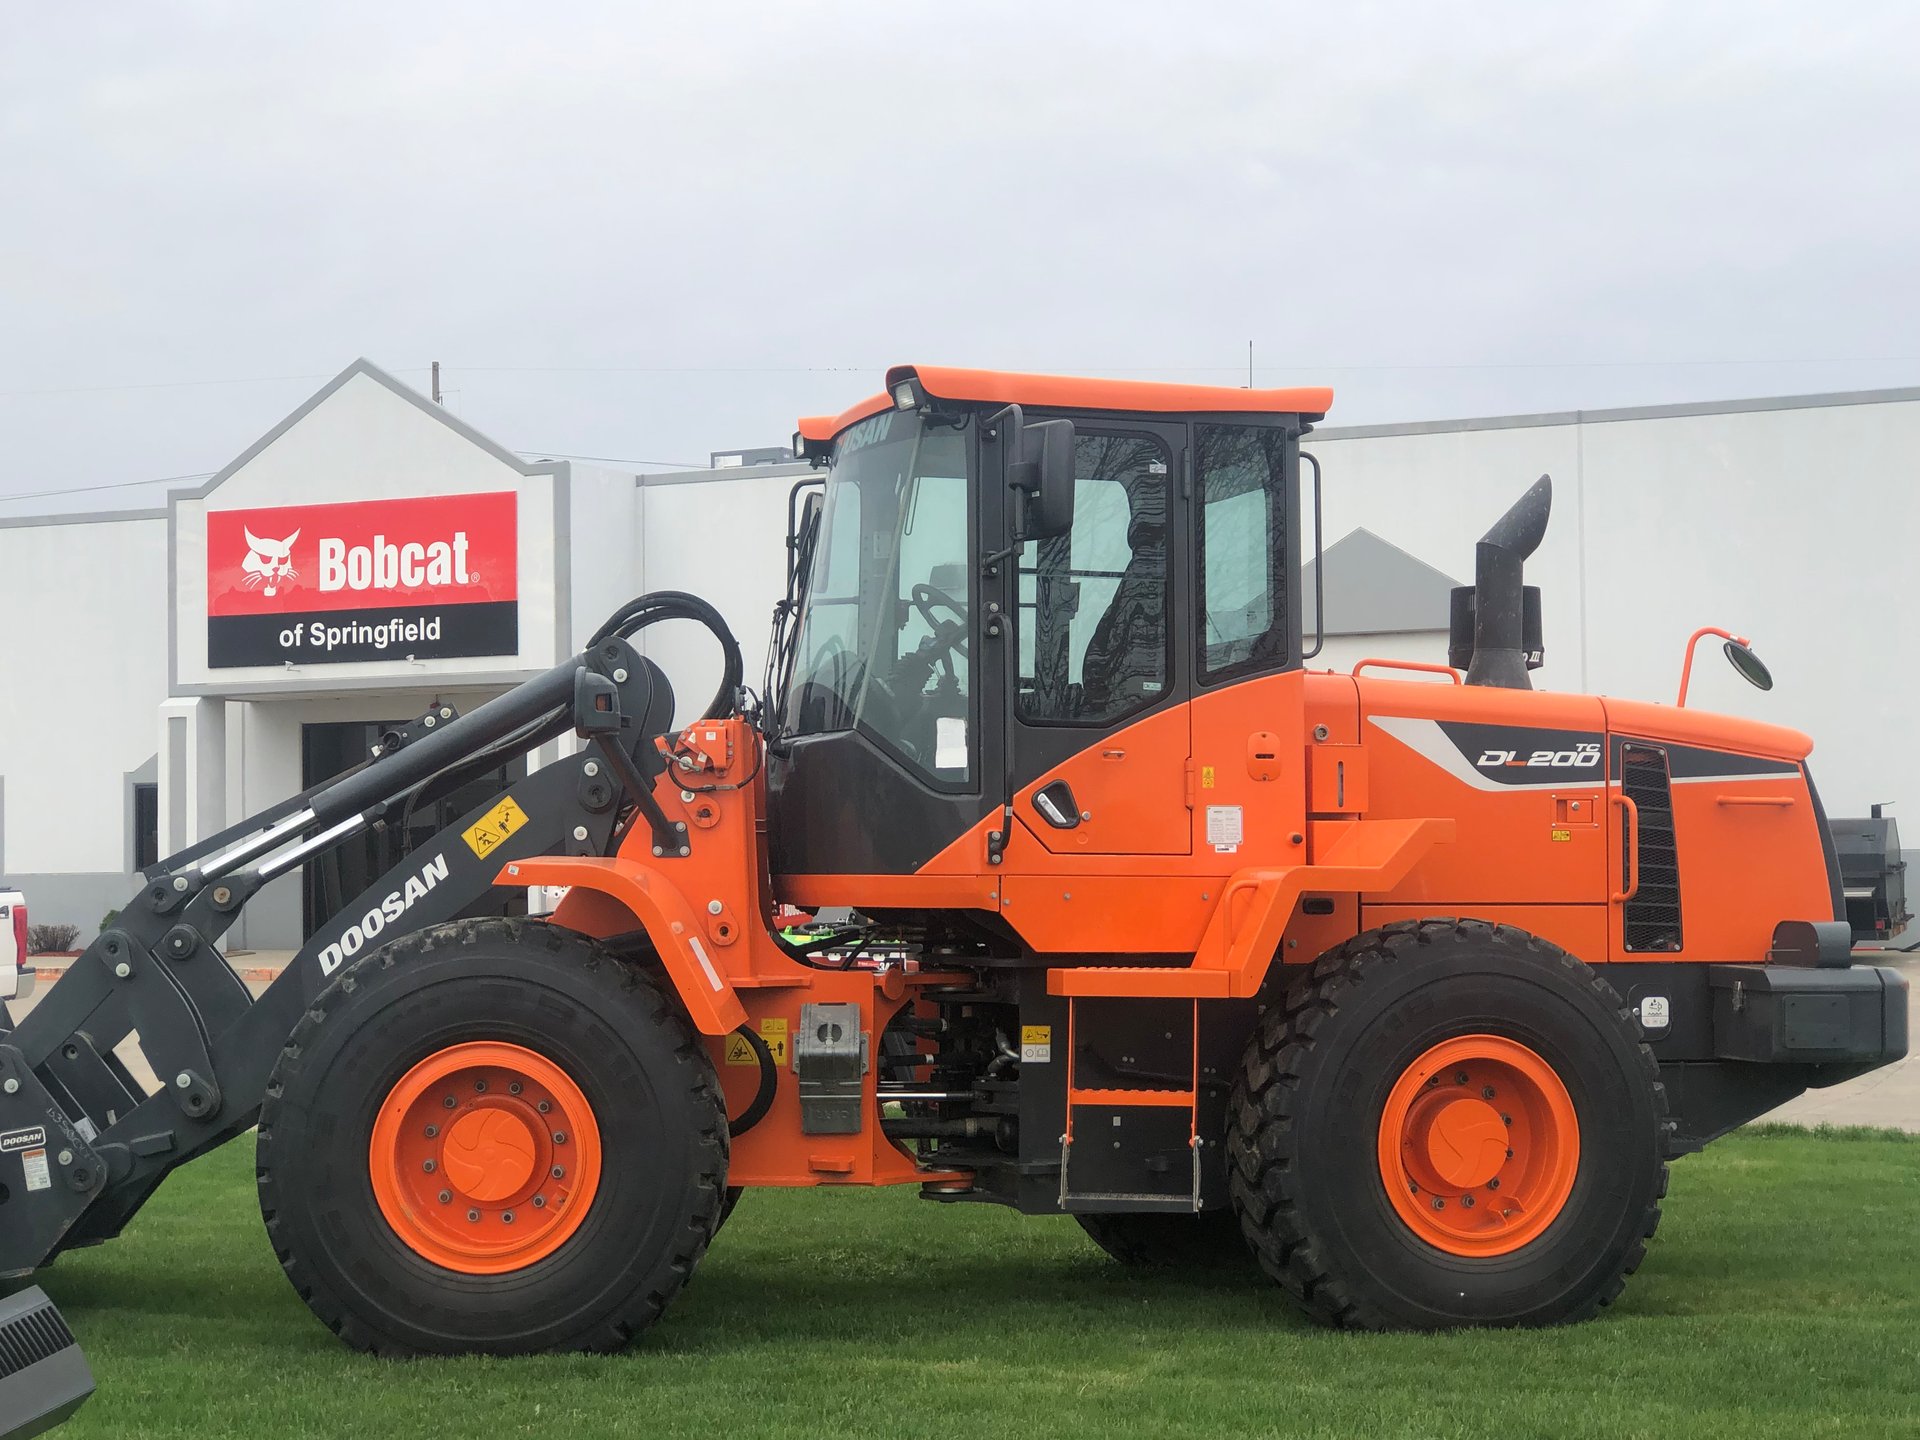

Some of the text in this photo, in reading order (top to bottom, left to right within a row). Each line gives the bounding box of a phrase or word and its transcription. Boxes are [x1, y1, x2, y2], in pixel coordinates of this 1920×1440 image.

[319, 531, 469, 592] Bobcat
[279, 616, 441, 651] of Springfield
[1476, 750, 1601, 767] DL200
[1575, 743, 1601, 753] TC
[317, 853, 450, 977] DOOSAN
[3, 1132, 42, 1147] DOOSAN
